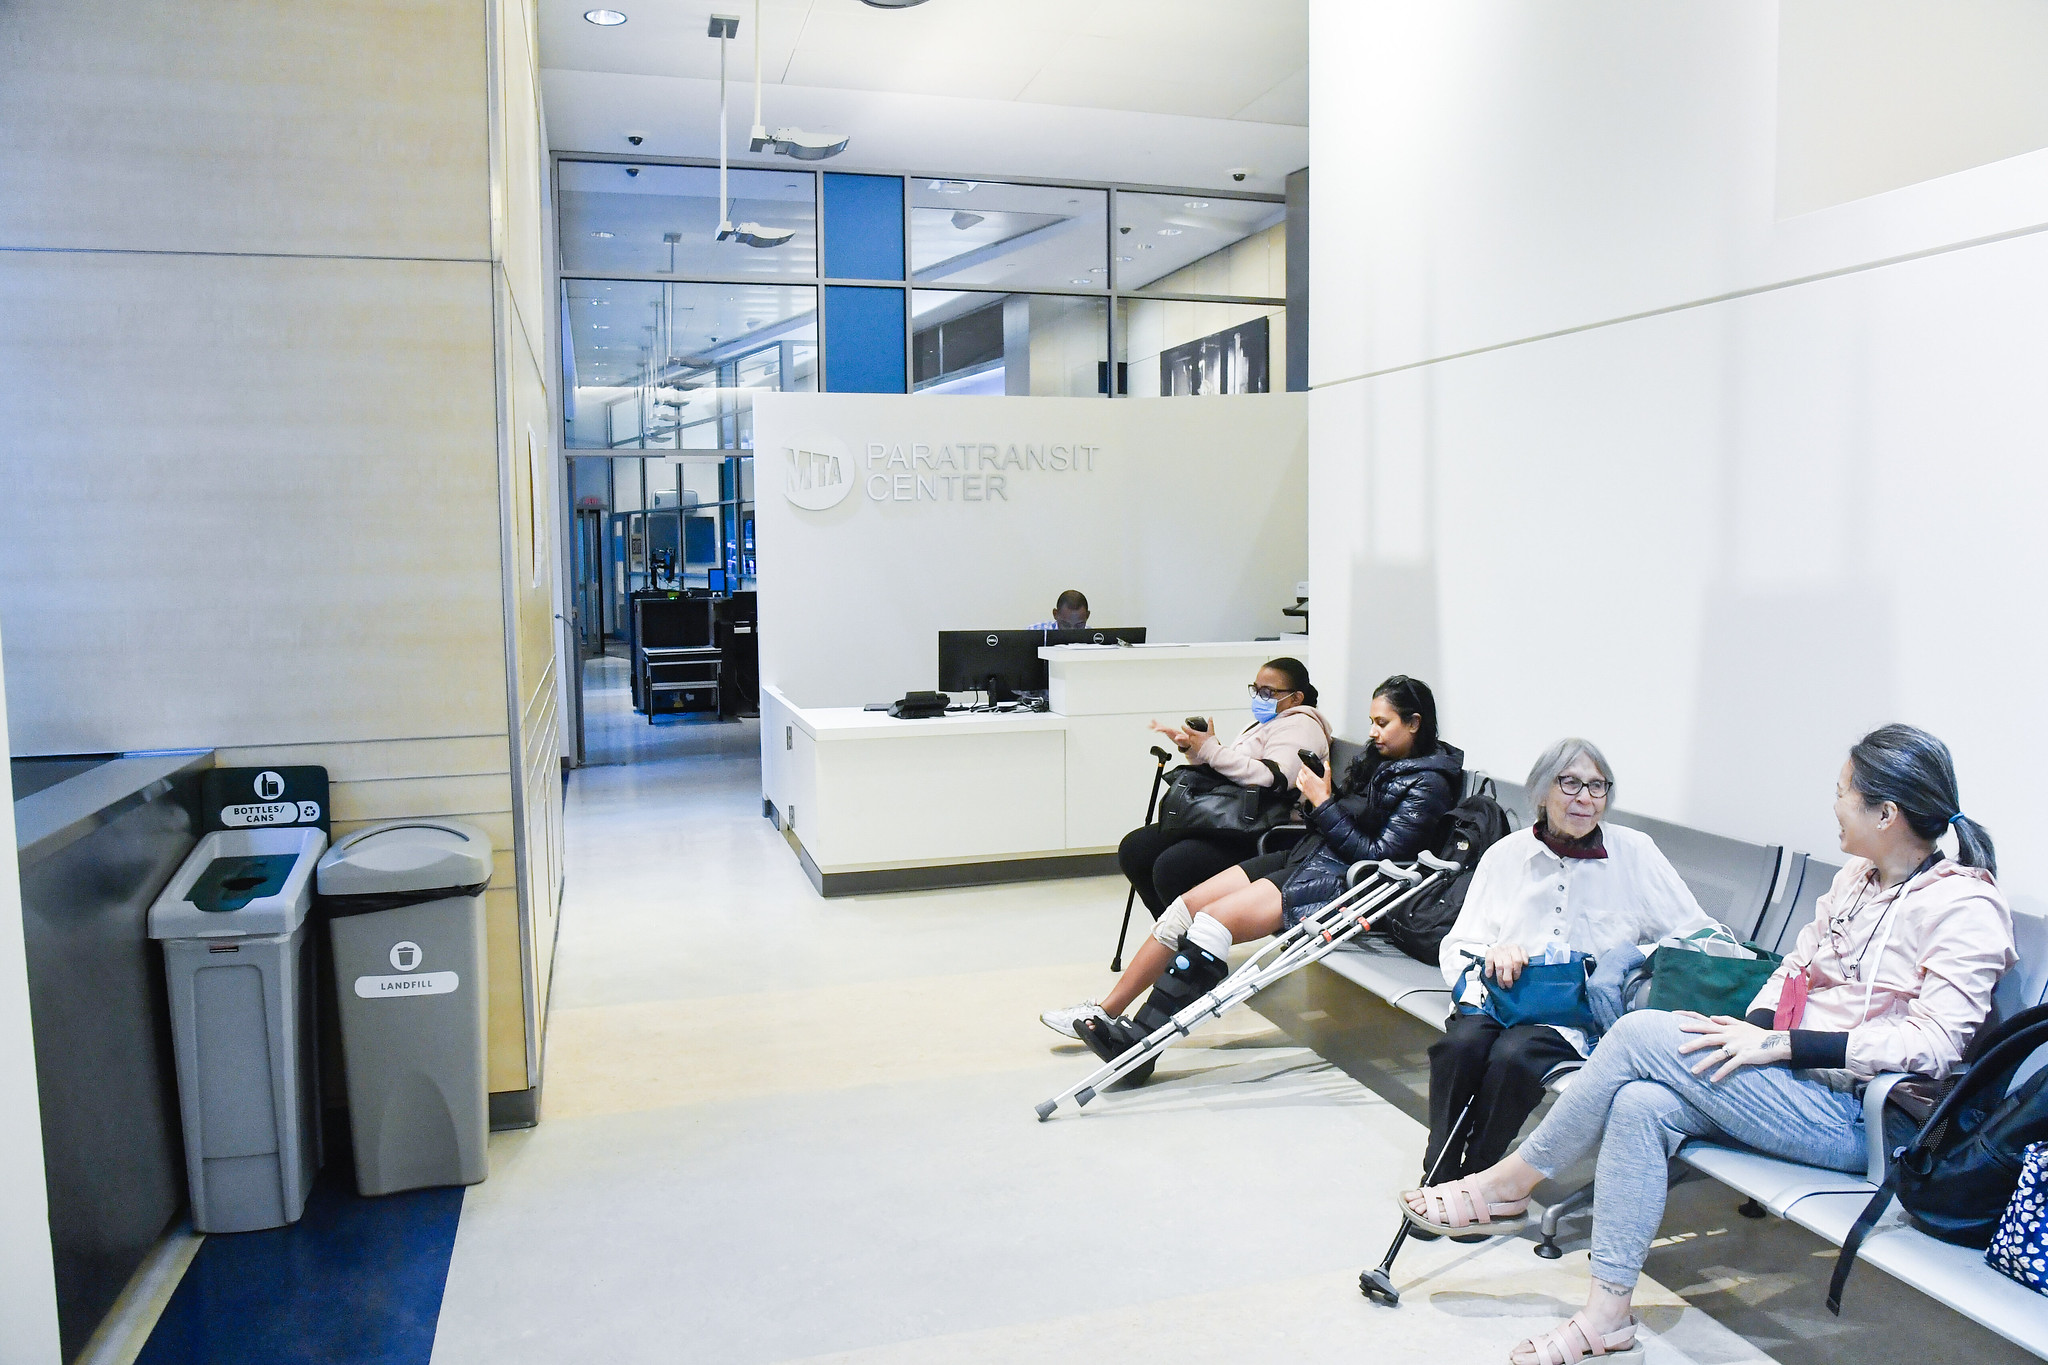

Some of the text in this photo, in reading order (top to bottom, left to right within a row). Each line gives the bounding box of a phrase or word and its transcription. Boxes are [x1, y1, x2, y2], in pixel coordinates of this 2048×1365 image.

[866, 442, 1099, 472] PARATRANSIT
[783, 447, 842, 492] MTA
[866, 474, 1008, 501] CENTER
[233, 805, 285, 815] BOTTLES/
[246, 814, 274, 823] CANS
[380, 980, 433, 991] LANDFILL
